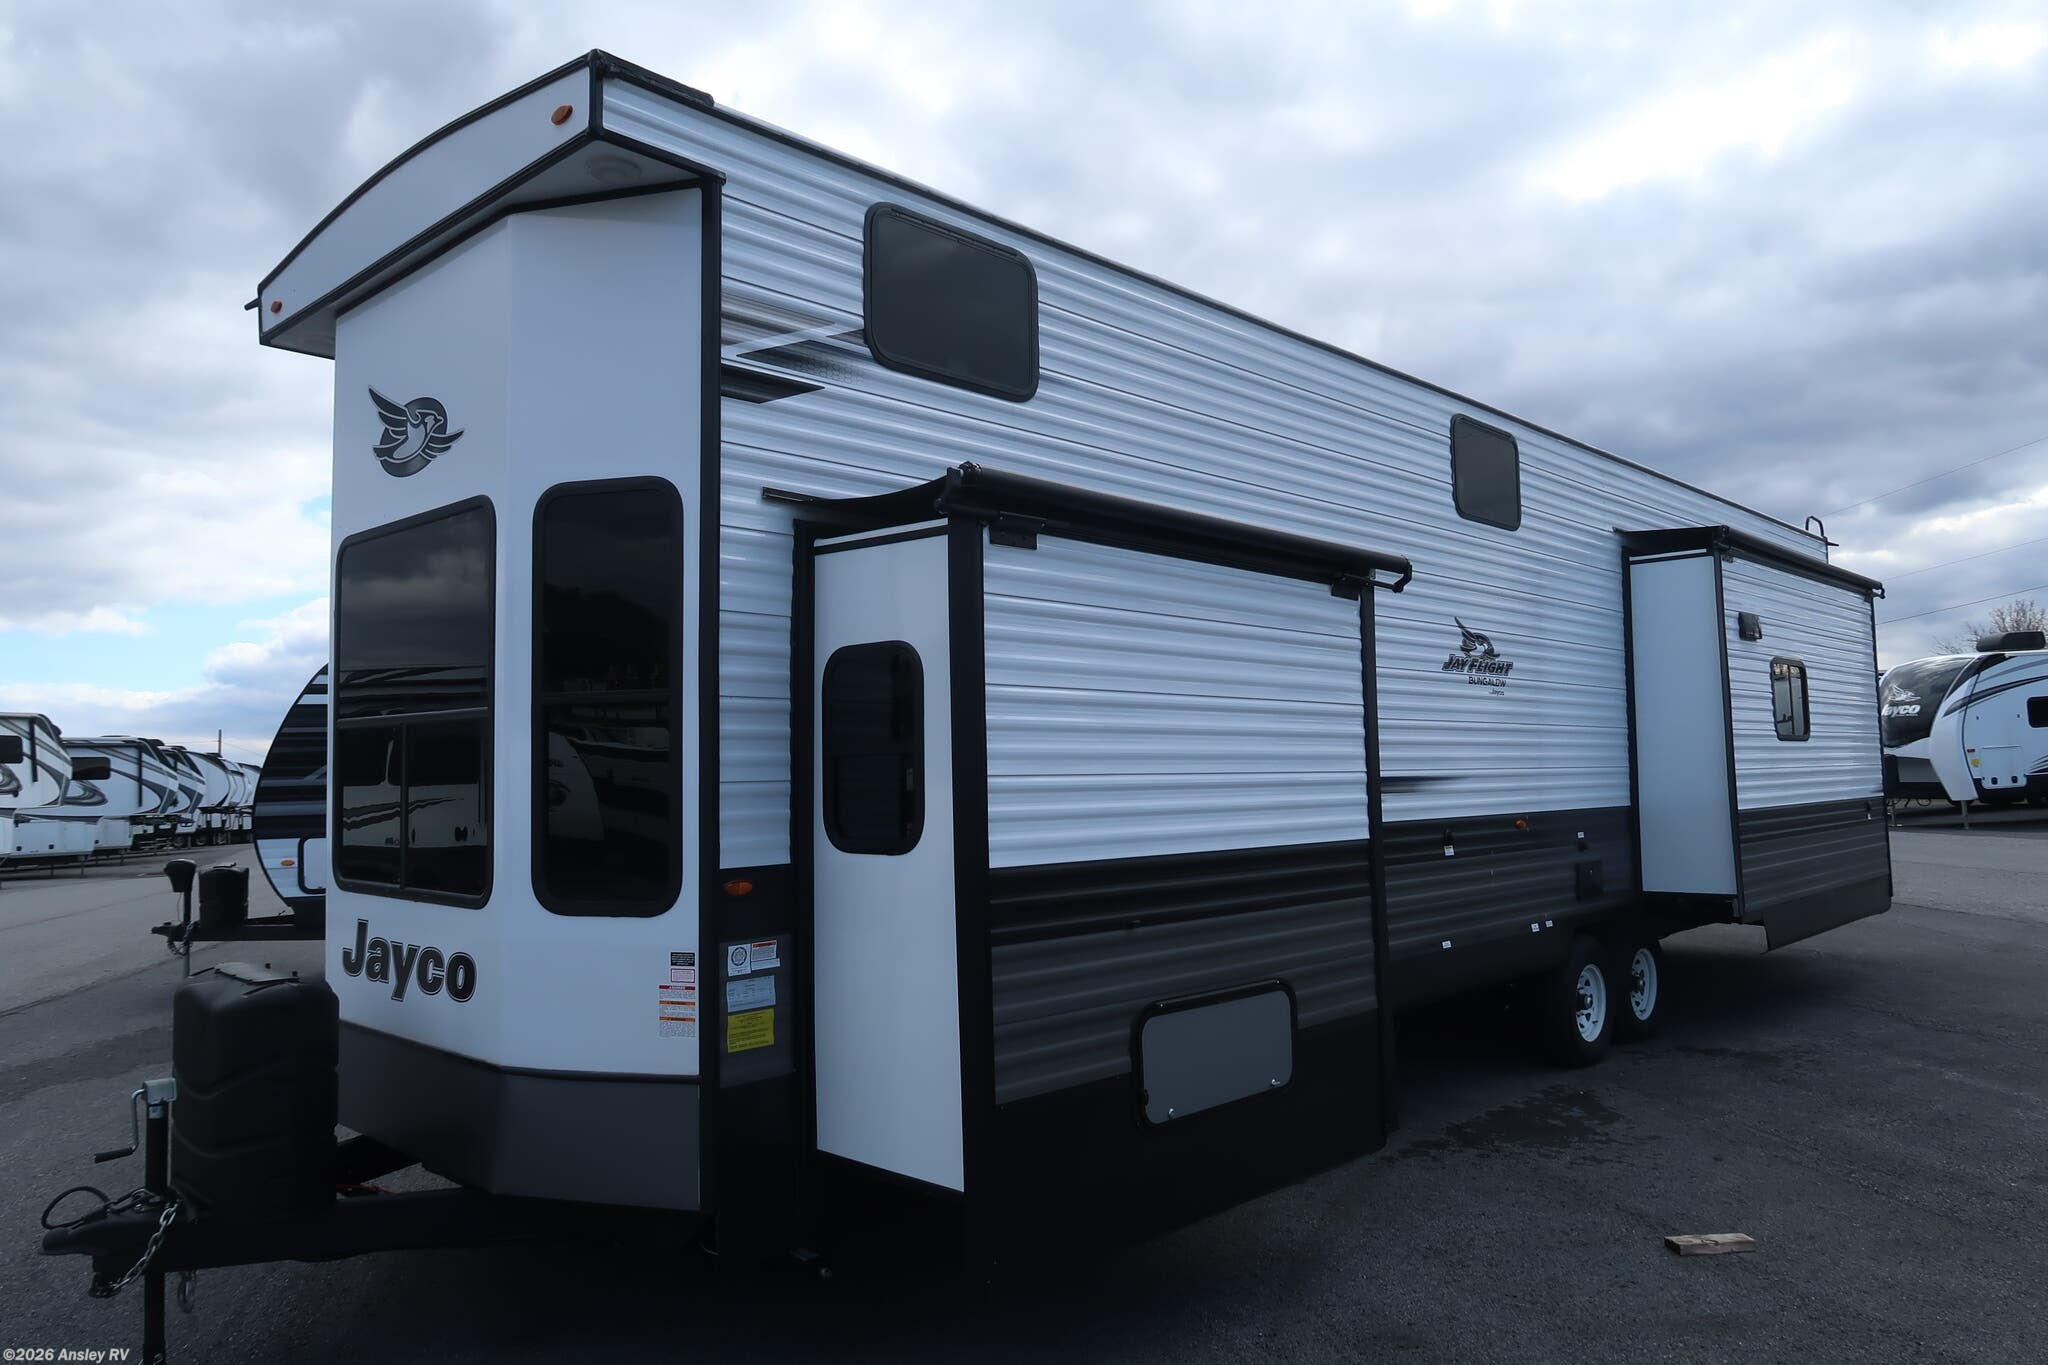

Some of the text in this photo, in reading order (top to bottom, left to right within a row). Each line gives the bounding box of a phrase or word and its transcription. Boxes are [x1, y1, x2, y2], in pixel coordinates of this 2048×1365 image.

[1441, 653, 1514, 676] JAY FLIGHT
[1468, 676, 1507, 687] BUNGALOW
[342, 918, 477, 1003] Jayco
